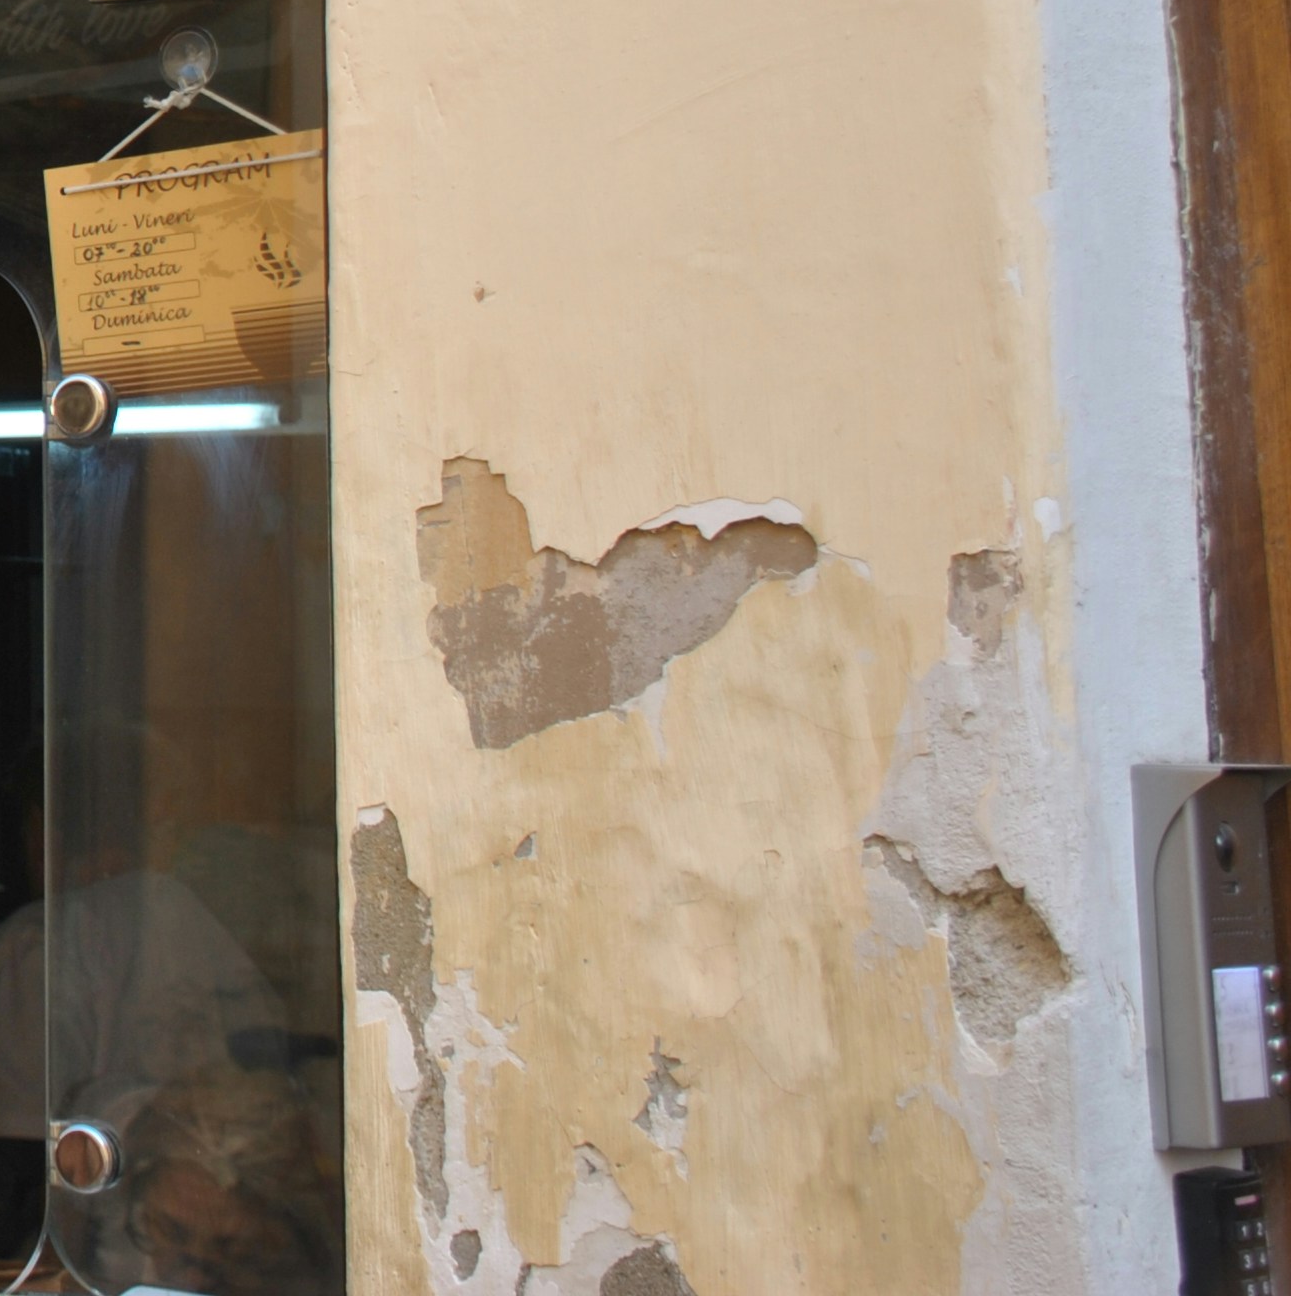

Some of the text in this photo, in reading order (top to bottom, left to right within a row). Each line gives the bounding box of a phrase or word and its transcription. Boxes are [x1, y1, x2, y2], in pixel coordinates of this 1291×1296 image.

[114, 152, 272, 201] PROGRAM
[72, 218, 118, 239] Luni
[133, 207, 196, 230] Vineri
[93, 261, 183, 287] Sambata
[91, 305, 193, 332] Duminica
